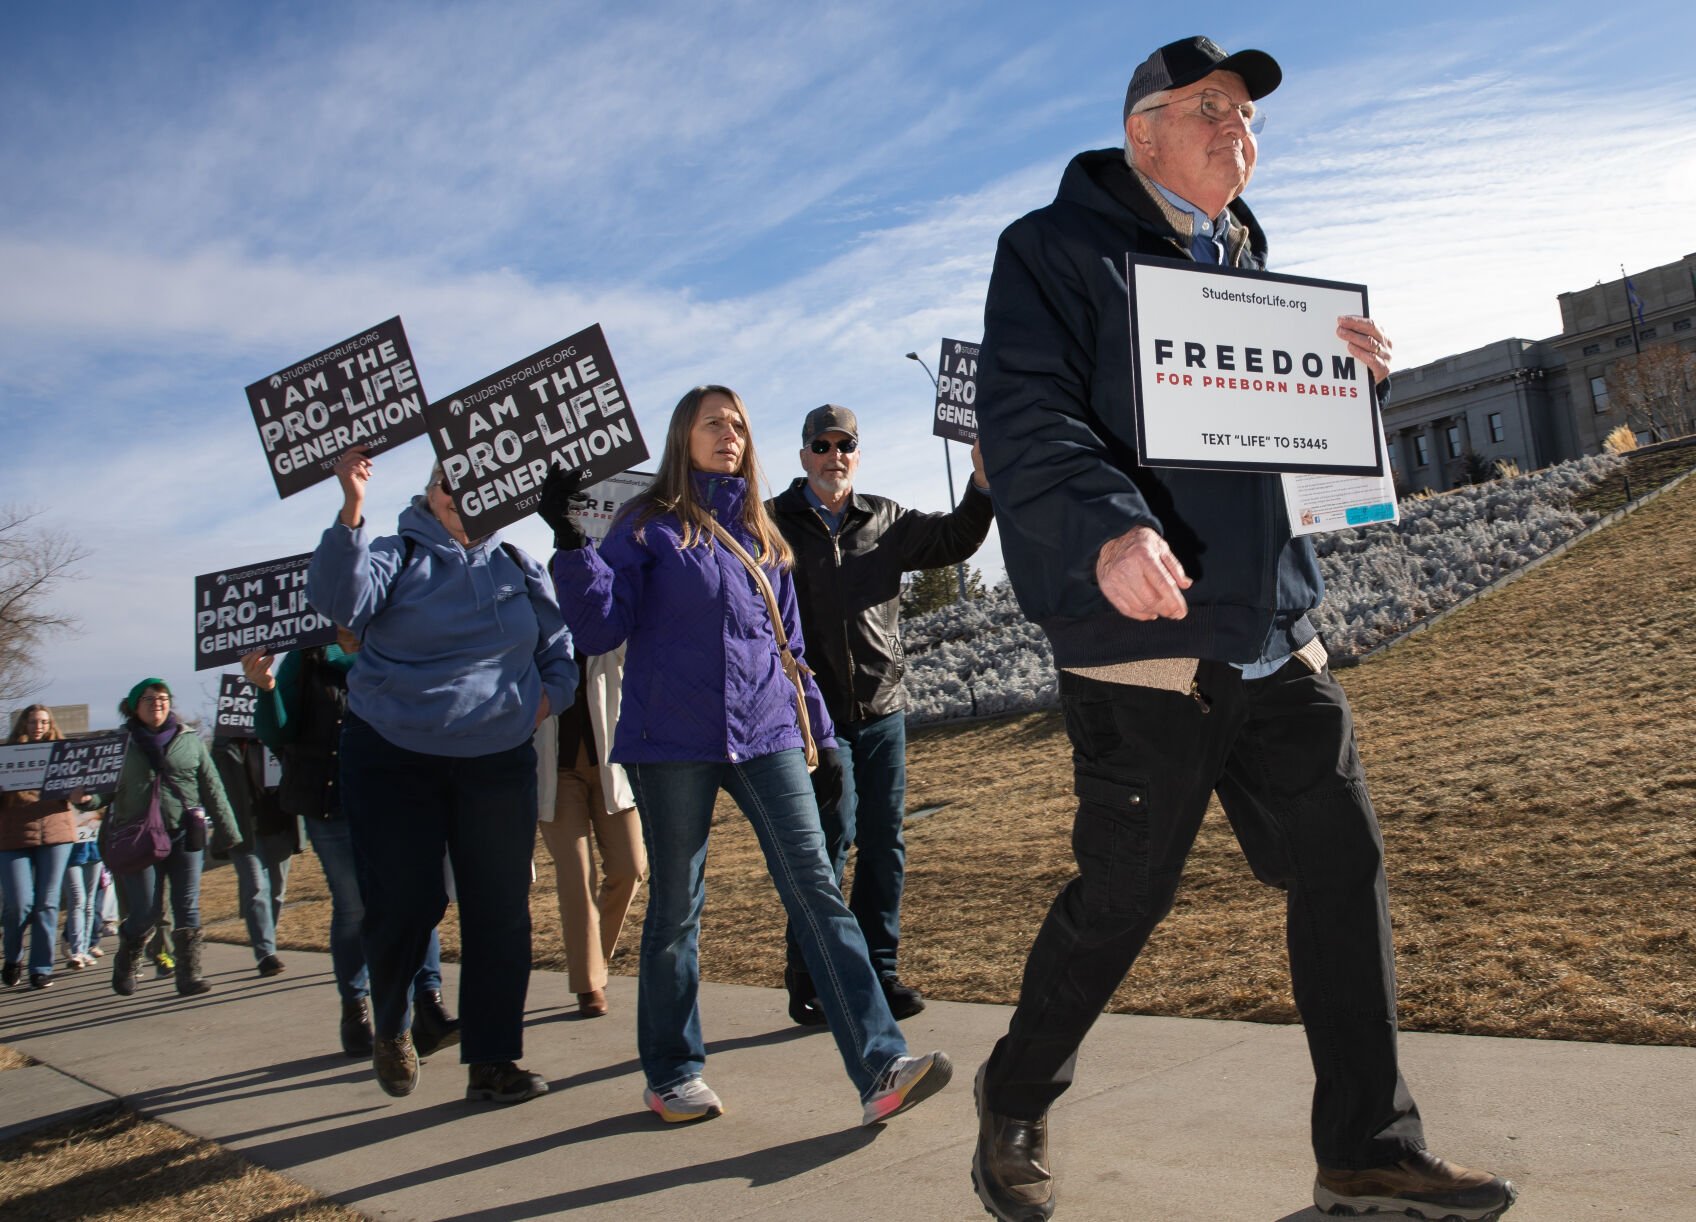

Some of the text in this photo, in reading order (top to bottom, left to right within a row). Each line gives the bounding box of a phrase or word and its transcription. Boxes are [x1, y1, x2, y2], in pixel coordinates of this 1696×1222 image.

[1202, 287, 1307, 312] StudentsforLife.org
[282, 331, 380, 382] STUDENTSFORLIFE.ORG
[944, 354, 950, 372] I
[1154, 338, 1357, 381] FREEDOM
[260, 339, 398, 418] I AM THE
[463, 345, 577, 409] STUDENTSFORLIFE.ORG
[1156, 372, 1358, 398] FOR PREBORN BABIES
[260, 359, 418, 453] PRO-LIFE
[439, 355, 600, 450] I AM THE
[274, 392, 422, 475] GENERATION
[364, 435, 388, 449] 3445
[442, 378, 625, 491] PRO-LIFE
[1201, 433, 1232, 446] TEXT
[1274, 436, 1290, 449] TO
[1293, 437, 1328, 450] 53445
[461, 417, 633, 517] GENERATION
[515, 496, 534, 511] TEXT
[203, 569, 308, 606] I AM TH
[197, 589, 308, 634] PRO-LIF
[200, 612, 332, 654] GENERATION
[226, 684, 258, 697] I A
[47, 755, 124, 778] PRO-LIFE
[54, 743, 123, 762] I AM THE
[44, 771, 119, 791] GENERATION
